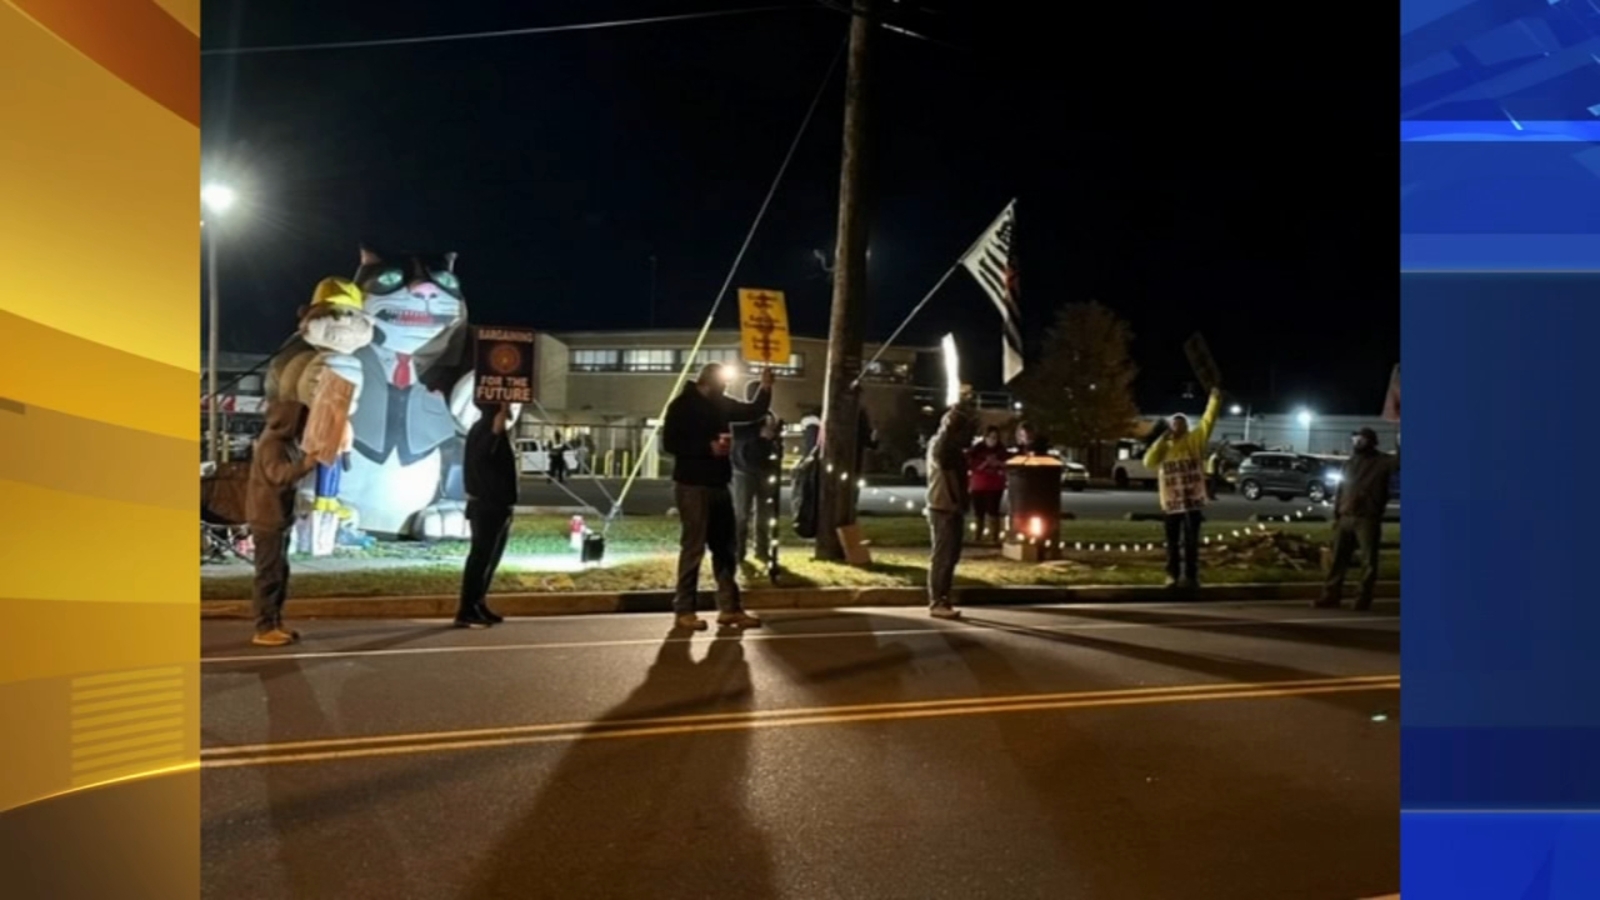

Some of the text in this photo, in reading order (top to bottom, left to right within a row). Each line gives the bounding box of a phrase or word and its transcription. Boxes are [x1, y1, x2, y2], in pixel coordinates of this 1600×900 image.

[478, 329, 533, 342] BARGAINING
[480, 375, 528, 387] FOR THE
[476, 386, 532, 401] FUTURE
